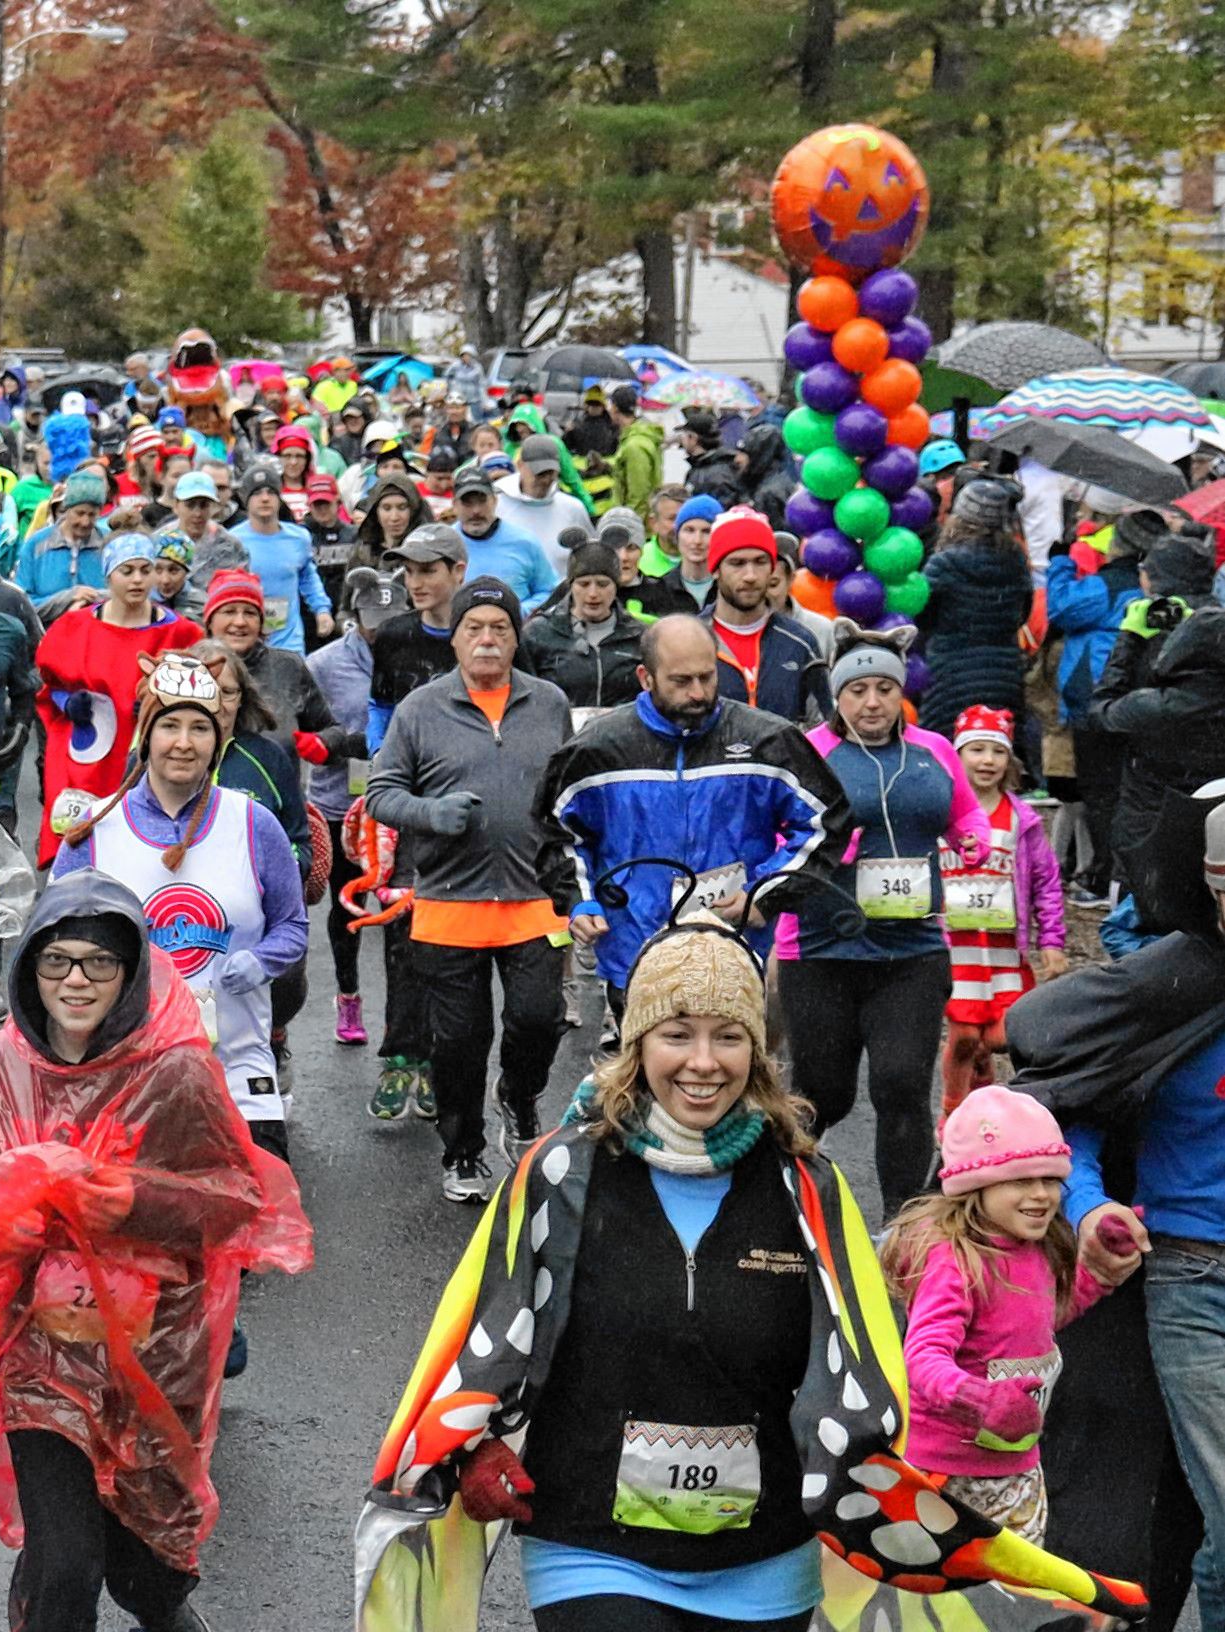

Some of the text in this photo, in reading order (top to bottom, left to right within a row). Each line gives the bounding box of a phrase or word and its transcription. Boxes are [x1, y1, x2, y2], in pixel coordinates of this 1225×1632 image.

[379, 588, 392, 605] B
[881, 878, 912, 896] 348
[967, 893, 993, 908] 357
[668, 1464, 718, 1491] 189
